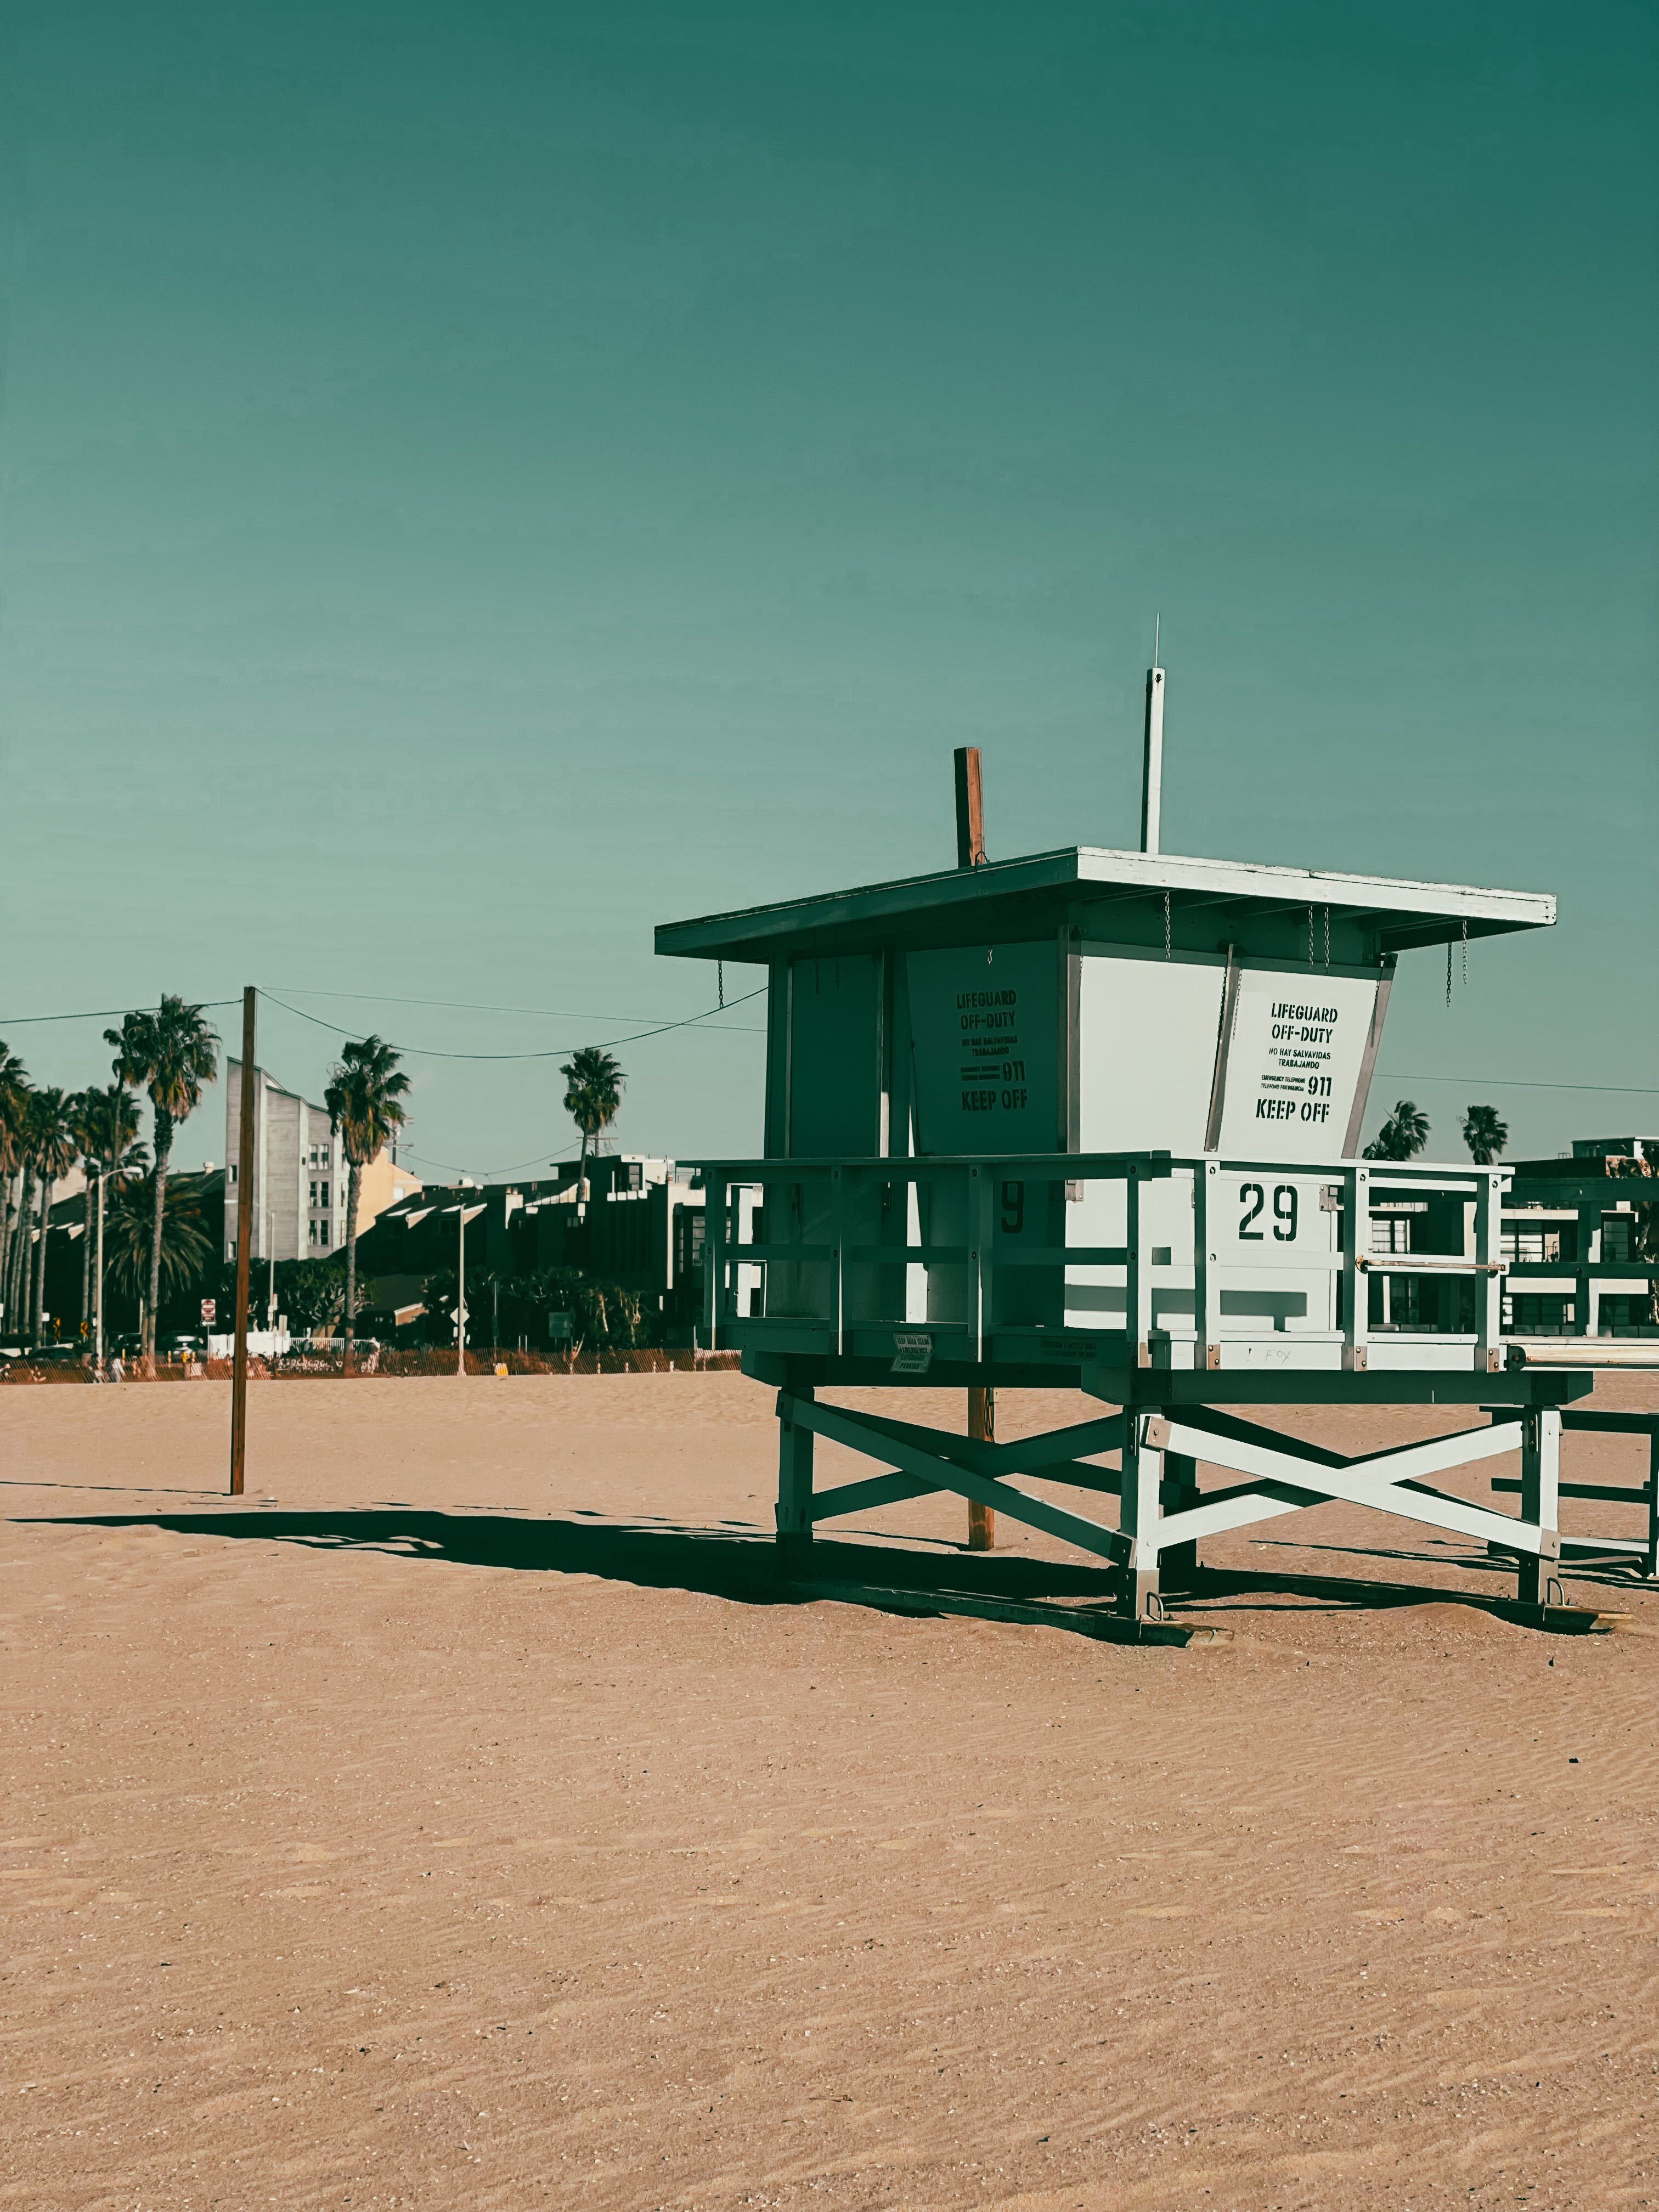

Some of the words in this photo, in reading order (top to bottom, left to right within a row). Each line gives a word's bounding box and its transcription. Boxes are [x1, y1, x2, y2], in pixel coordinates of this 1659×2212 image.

[957, 990, 1017, 1009] LIFEGUARD
[961, 1011, 1015, 1030] OFF-DUTY
[1271, 1003, 1338, 1023] LIFEGUARD
[962, 1039, 970, 1047] NO
[971, 1037, 981, 1046] HAY
[1272, 1024, 1333, 1043] OFF-DUTY
[1278, 1058, 1319, 1069] TRABAJANDO
[1279, 1048, 1291, 1057] HAY
[1293, 1049, 1331, 1060] SALVAVIDAS
[1002, 1060, 1025, 1082] 911
[1308, 1076, 1332, 1097] 911
[962, 1090, 996, 1111] KEEP
[1001, 1088, 1028, 1109] OFF
[1256, 1098, 1296, 1120] KEEP
[1301, 1102, 1330, 1123] OFF
[1239, 1183, 1299, 1242] 29
